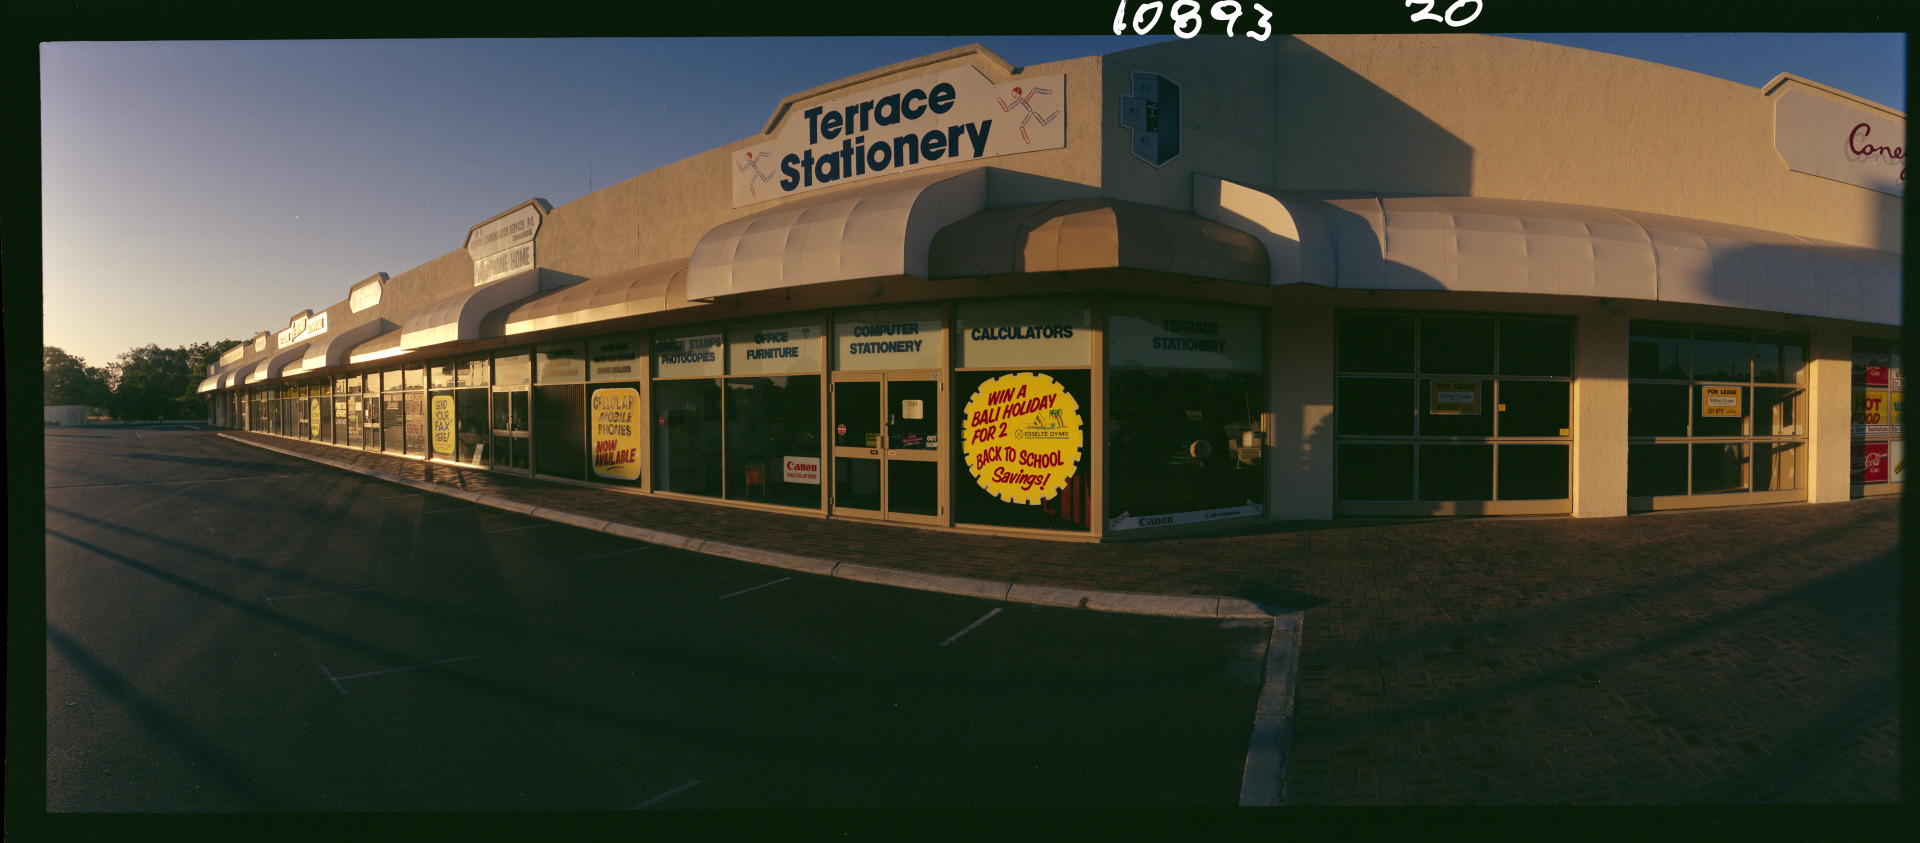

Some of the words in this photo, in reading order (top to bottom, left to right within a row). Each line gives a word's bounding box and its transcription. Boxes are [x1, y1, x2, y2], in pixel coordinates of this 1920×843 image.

[803, 81, 957, 145] Terrace
[779, 118, 993, 192] Stationery
[511, 247, 530, 269] HOME
[853, 323, 919, 337] COMPUTER
[971, 325, 1074, 341] CALCULATORS
[1161, 319, 1218, 335] TERRACE
[689, 337, 722, 349] STAMPS
[754, 332, 789, 344] OFFICE
[1152, 336, 1227, 353] STATIONERY
[746, 347, 799, 360] FURNITURE
[849, 340, 923, 355] STATIONERY
[661, 352, 716, 364] PHOTOCOPIES
[988, 387, 1016, 406] WIN
[1016, 384, 1027, 399] A
[434, 399, 448, 410] SEND
[593, 395, 635, 411] CELLULAR
[971, 406, 1002, 427] BALI
[1002, 393, 1057, 420] HOLIDAY
[1855, 398, 1882, 411] HOT
[434, 411, 450, 422] YOUR
[598, 412, 633, 423] MOBILE
[1851, 413, 1881, 424] FOOD
[598, 423, 632, 436] PHONES
[971, 425, 996, 445] FOR
[998, 422, 1008, 438] 2
[595, 439, 618, 453] NOW
[595, 448, 637, 467] AVAILABLE
[976, 446, 1002, 470] BACK
[1004, 446, 1017, 462] TO
[1019, 450, 1064, 469] SCHOOL
[786, 461, 818, 472] Canon
[786, 472, 817, 480] CALCULATORS
[992, 467, 1051, 491] Savings!
[1138, 516, 1173, 527] Canon
[1204, 510, 1241, 519] Calculators
